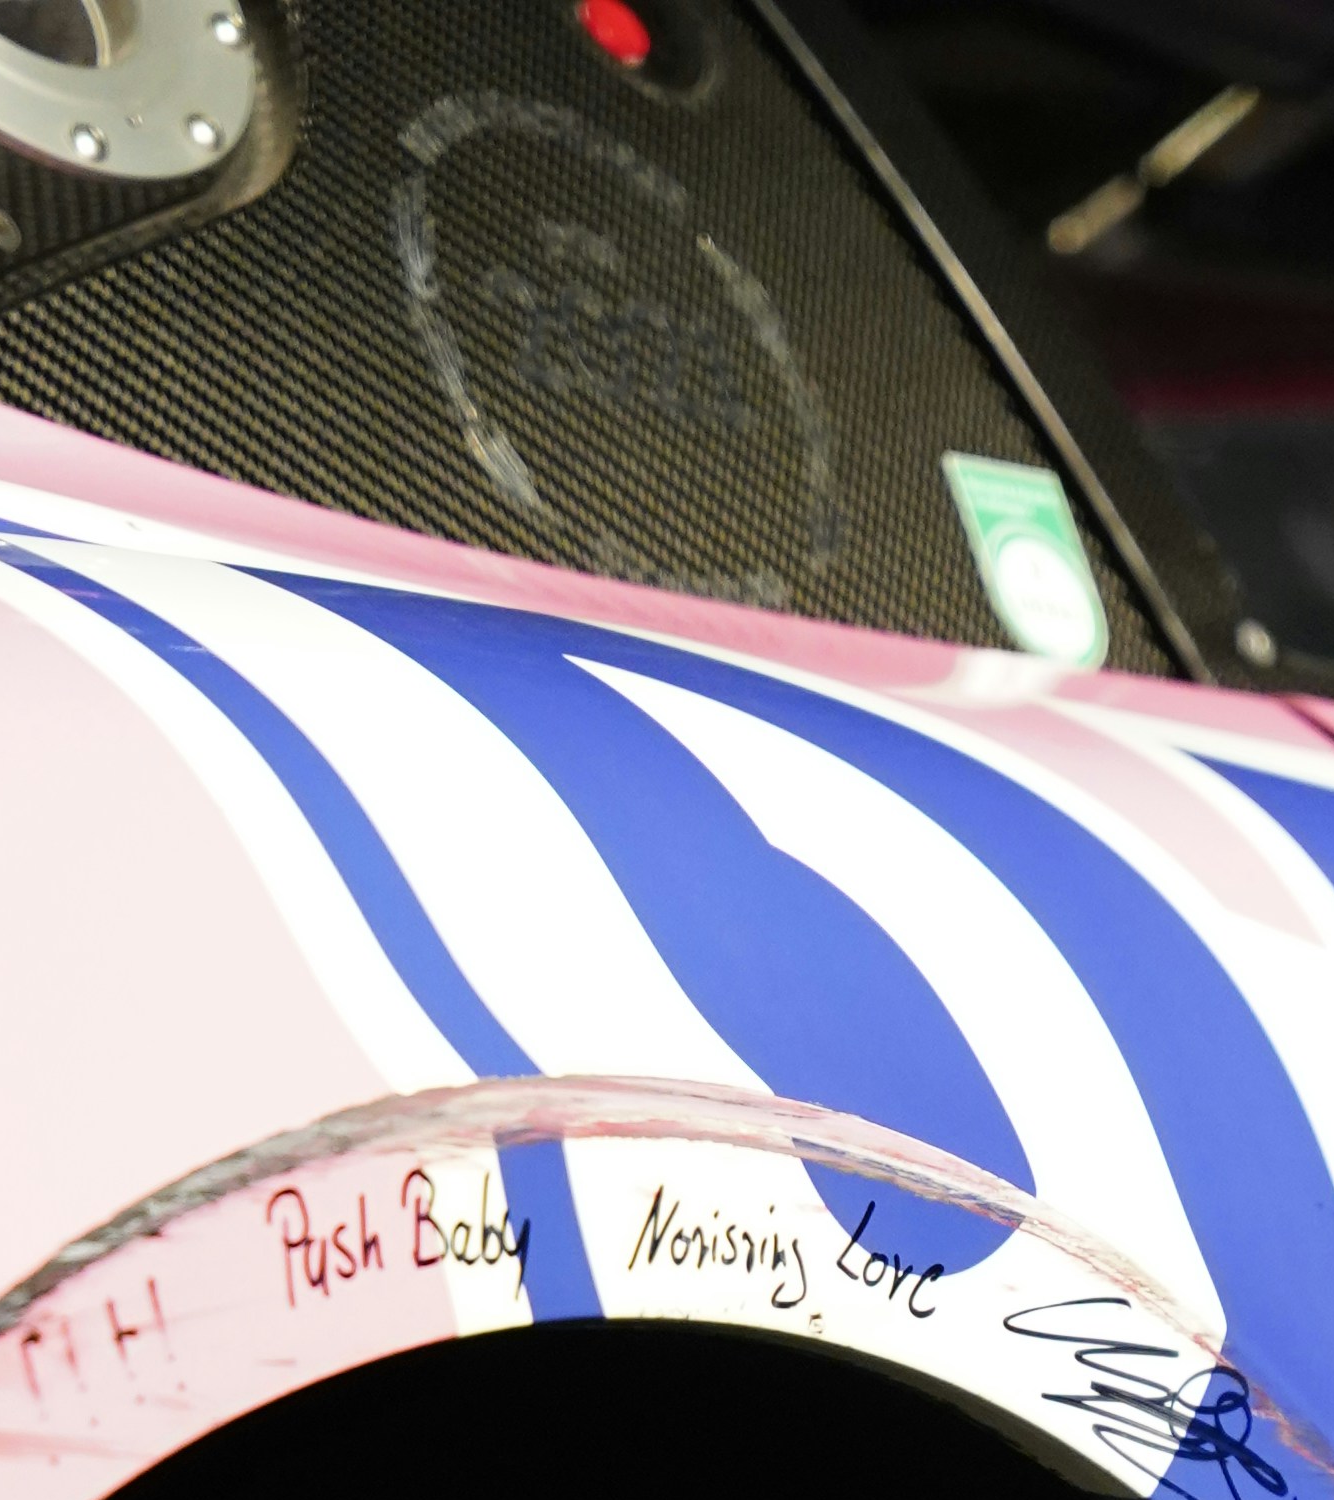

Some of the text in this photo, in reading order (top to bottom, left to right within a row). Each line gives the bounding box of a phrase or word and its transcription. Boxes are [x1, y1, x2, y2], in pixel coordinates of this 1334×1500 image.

[266, 1185, 385, 1310] Push
[400, 1167, 533, 1302] Baby
[835, 1199, 947, 1320] Love
